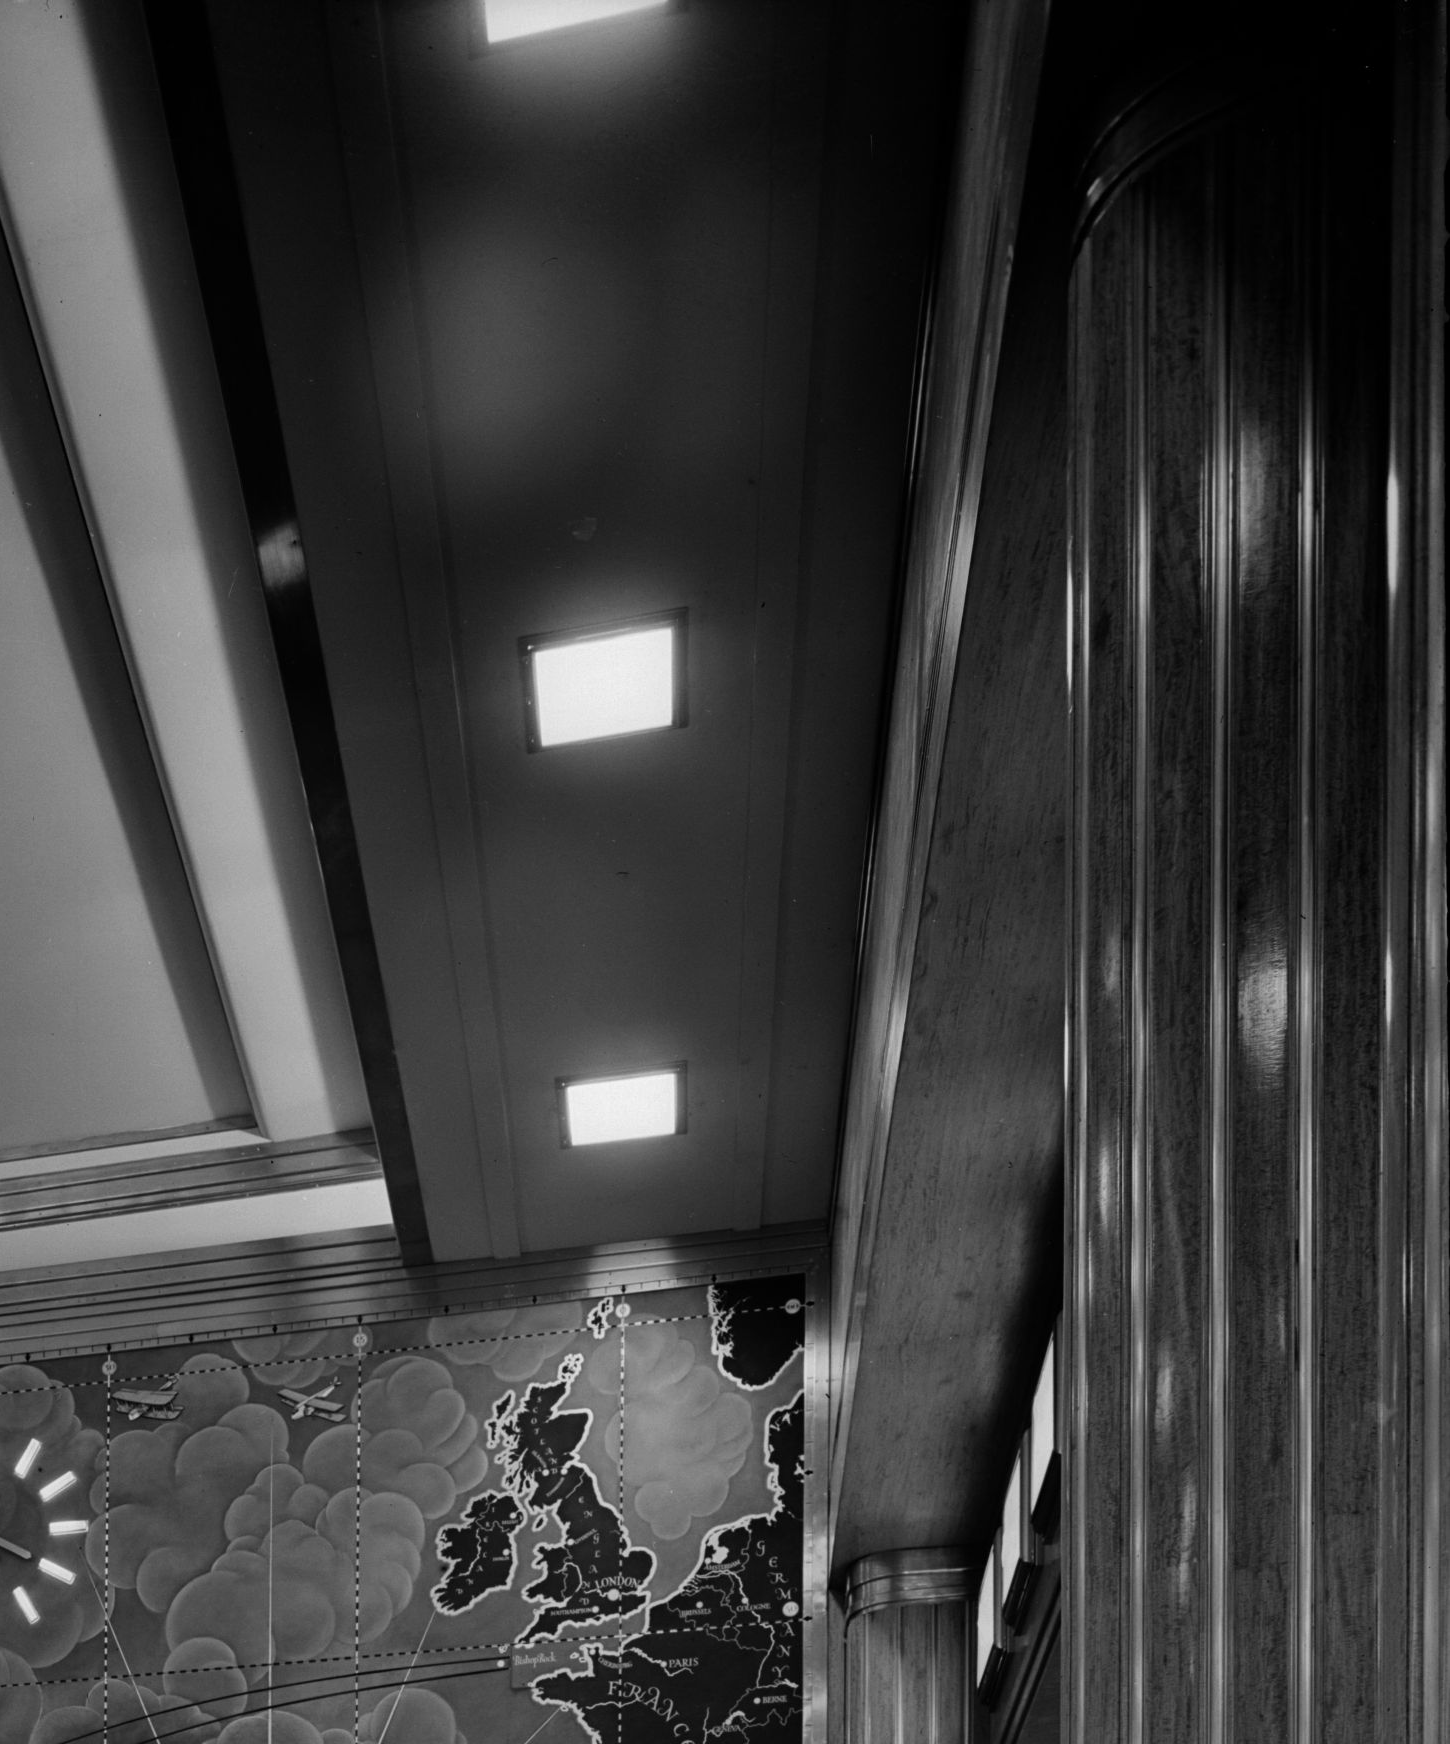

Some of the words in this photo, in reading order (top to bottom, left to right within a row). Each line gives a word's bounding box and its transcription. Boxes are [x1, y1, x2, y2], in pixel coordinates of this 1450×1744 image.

[578, 1495, 601, 1606] ENGLAND
[594, 1576, 642, 1590] LONDON
[735, 1602, 771, 1612] COLOGNE
[754, 1540, 798, 1678] GERMANY
[668, 1657, 700, 1669] PARIS
[762, 1695, 788, 1704] BERNE
